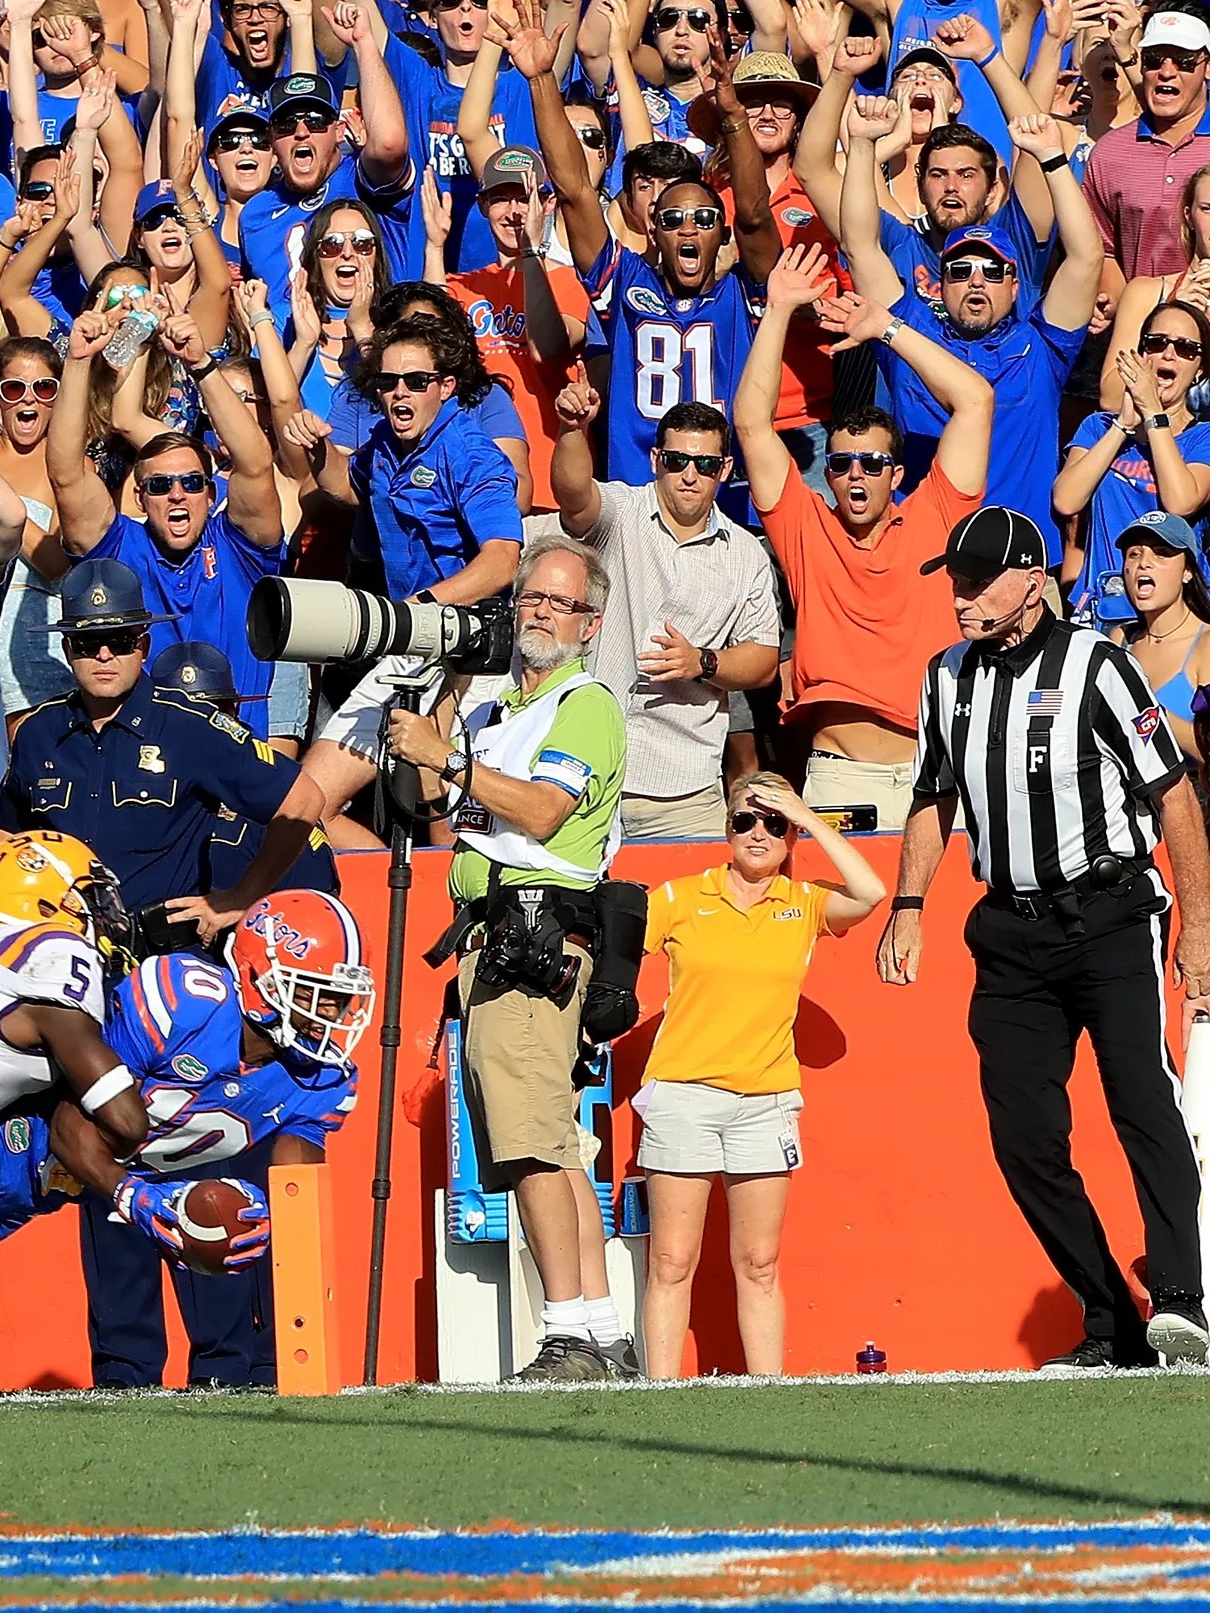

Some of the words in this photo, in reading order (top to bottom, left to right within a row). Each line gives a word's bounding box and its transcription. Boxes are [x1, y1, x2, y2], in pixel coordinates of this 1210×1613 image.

[472, 301, 527, 337] Gato
[635, 320, 726, 420] 81
[201, 547, 218, 579] F
[1029, 746, 1048, 773] F
[773, 908, 801, 920] LSU
[62, 955, 91, 1002] 5
[449, 1033, 460, 1179] POWERADE
